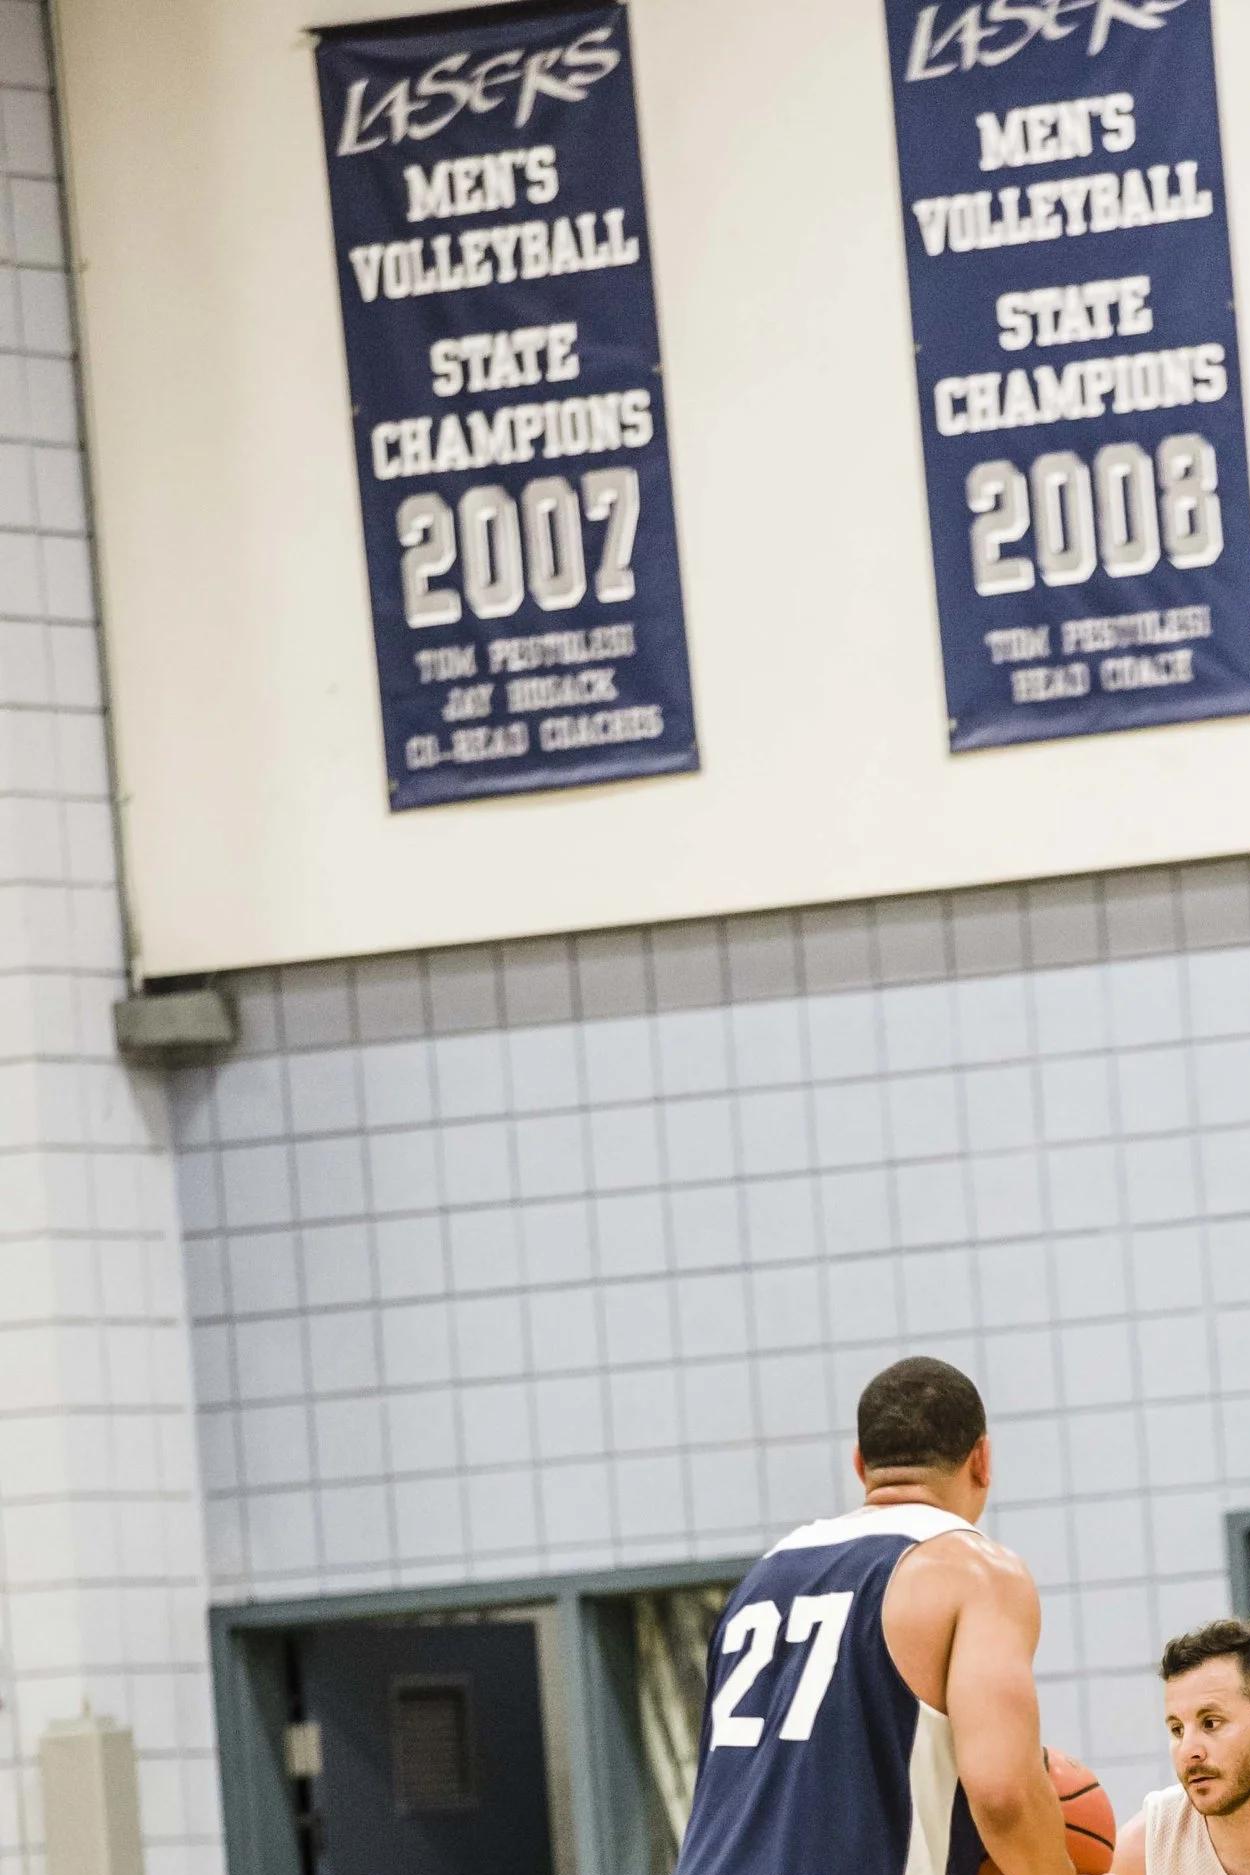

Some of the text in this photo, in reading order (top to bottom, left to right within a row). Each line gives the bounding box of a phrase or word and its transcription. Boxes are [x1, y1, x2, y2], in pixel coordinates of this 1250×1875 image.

[905, 0, 1187, 82] LASER
[337, 28, 621, 156] LASERS
[976, 92, 1136, 172] MEN'S
[403, 144, 559, 222] MEN'S
[913, 160, 1213, 256] VOLLEYBALL
[349, 207, 640, 302] VOLLEYBALL
[996, 275, 1153, 351] STATE
[429, 322, 580, 397] STATE
[935, 343, 1227, 436] CHAMPIONS
[371, 389, 654, 480] CHAMPIONS
[396, 466, 640, 629] 2007
[966, 432, 1224, 597] 2008
[415, 642, 477, 684] TOM
[984, 625, 1051, 665] TOM
[1011, 648, 1194, 704] HEAD COACH
[539, 704, 664, 752] COACHES
[710, 1591, 854, 1752] 27
